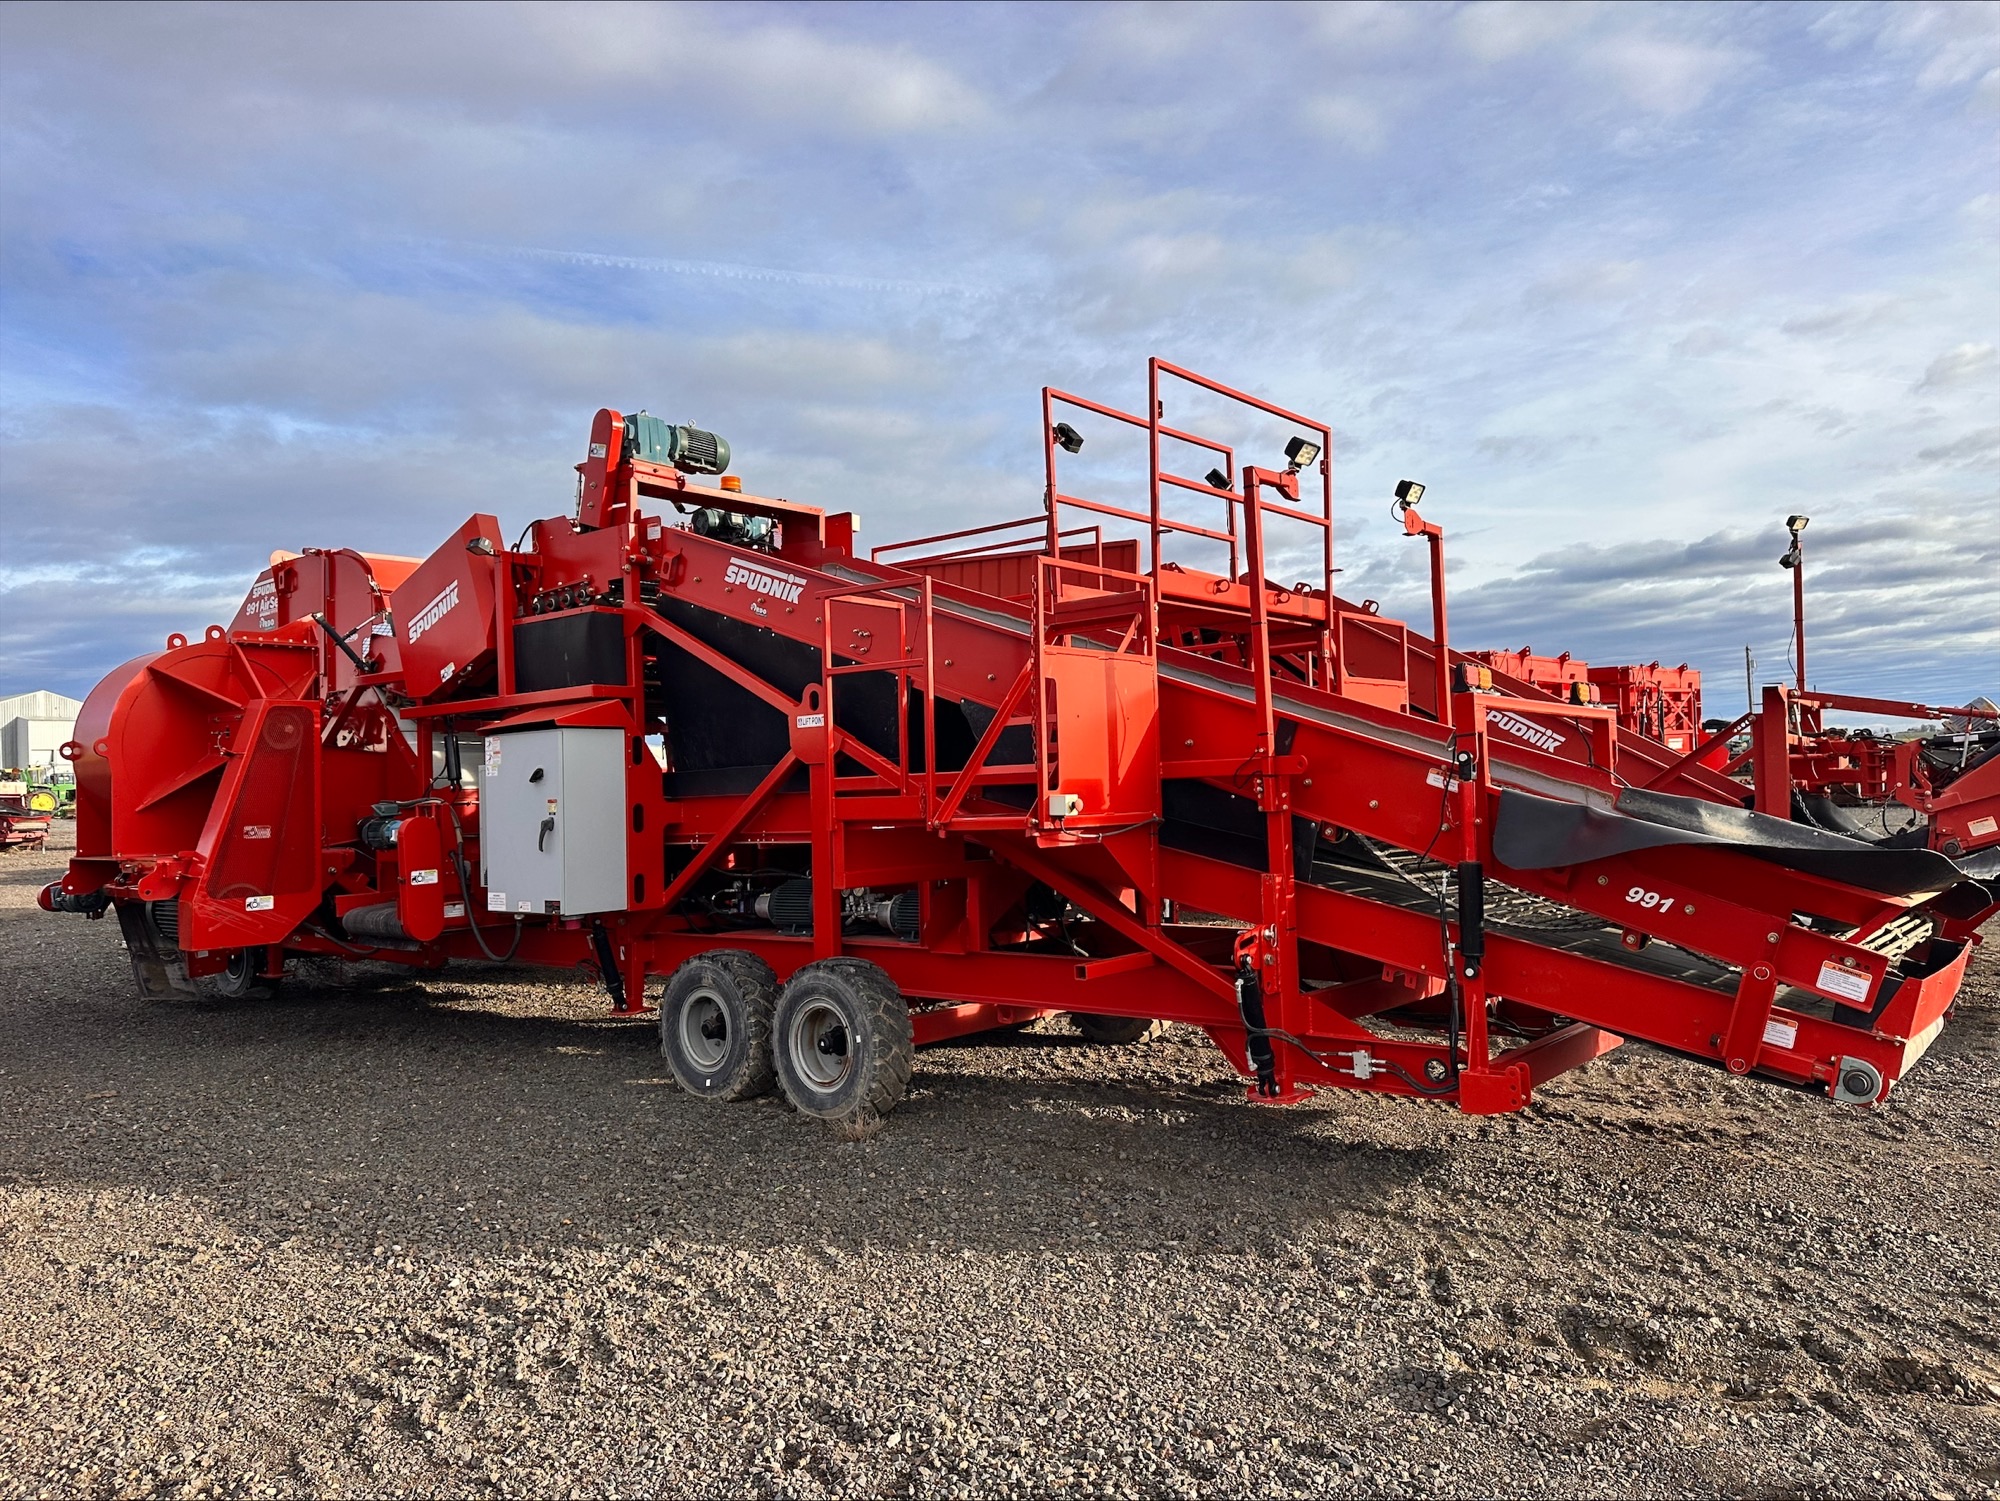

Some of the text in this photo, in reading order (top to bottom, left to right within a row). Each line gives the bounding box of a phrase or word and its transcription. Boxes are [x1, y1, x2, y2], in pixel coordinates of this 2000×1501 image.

[252, 582, 276, 598] SPUDN
[724, 565, 804, 605] SPUDNIK
[246, 601, 260, 616] 991
[408, 586, 460, 645] SPUDNIK
[803, 717, 811, 726] LIFT
[1486, 710, 1562, 754] PUDNIK
[1625, 887, 1675, 914] 991
[1838, 967, 1862, 979] WARNING
